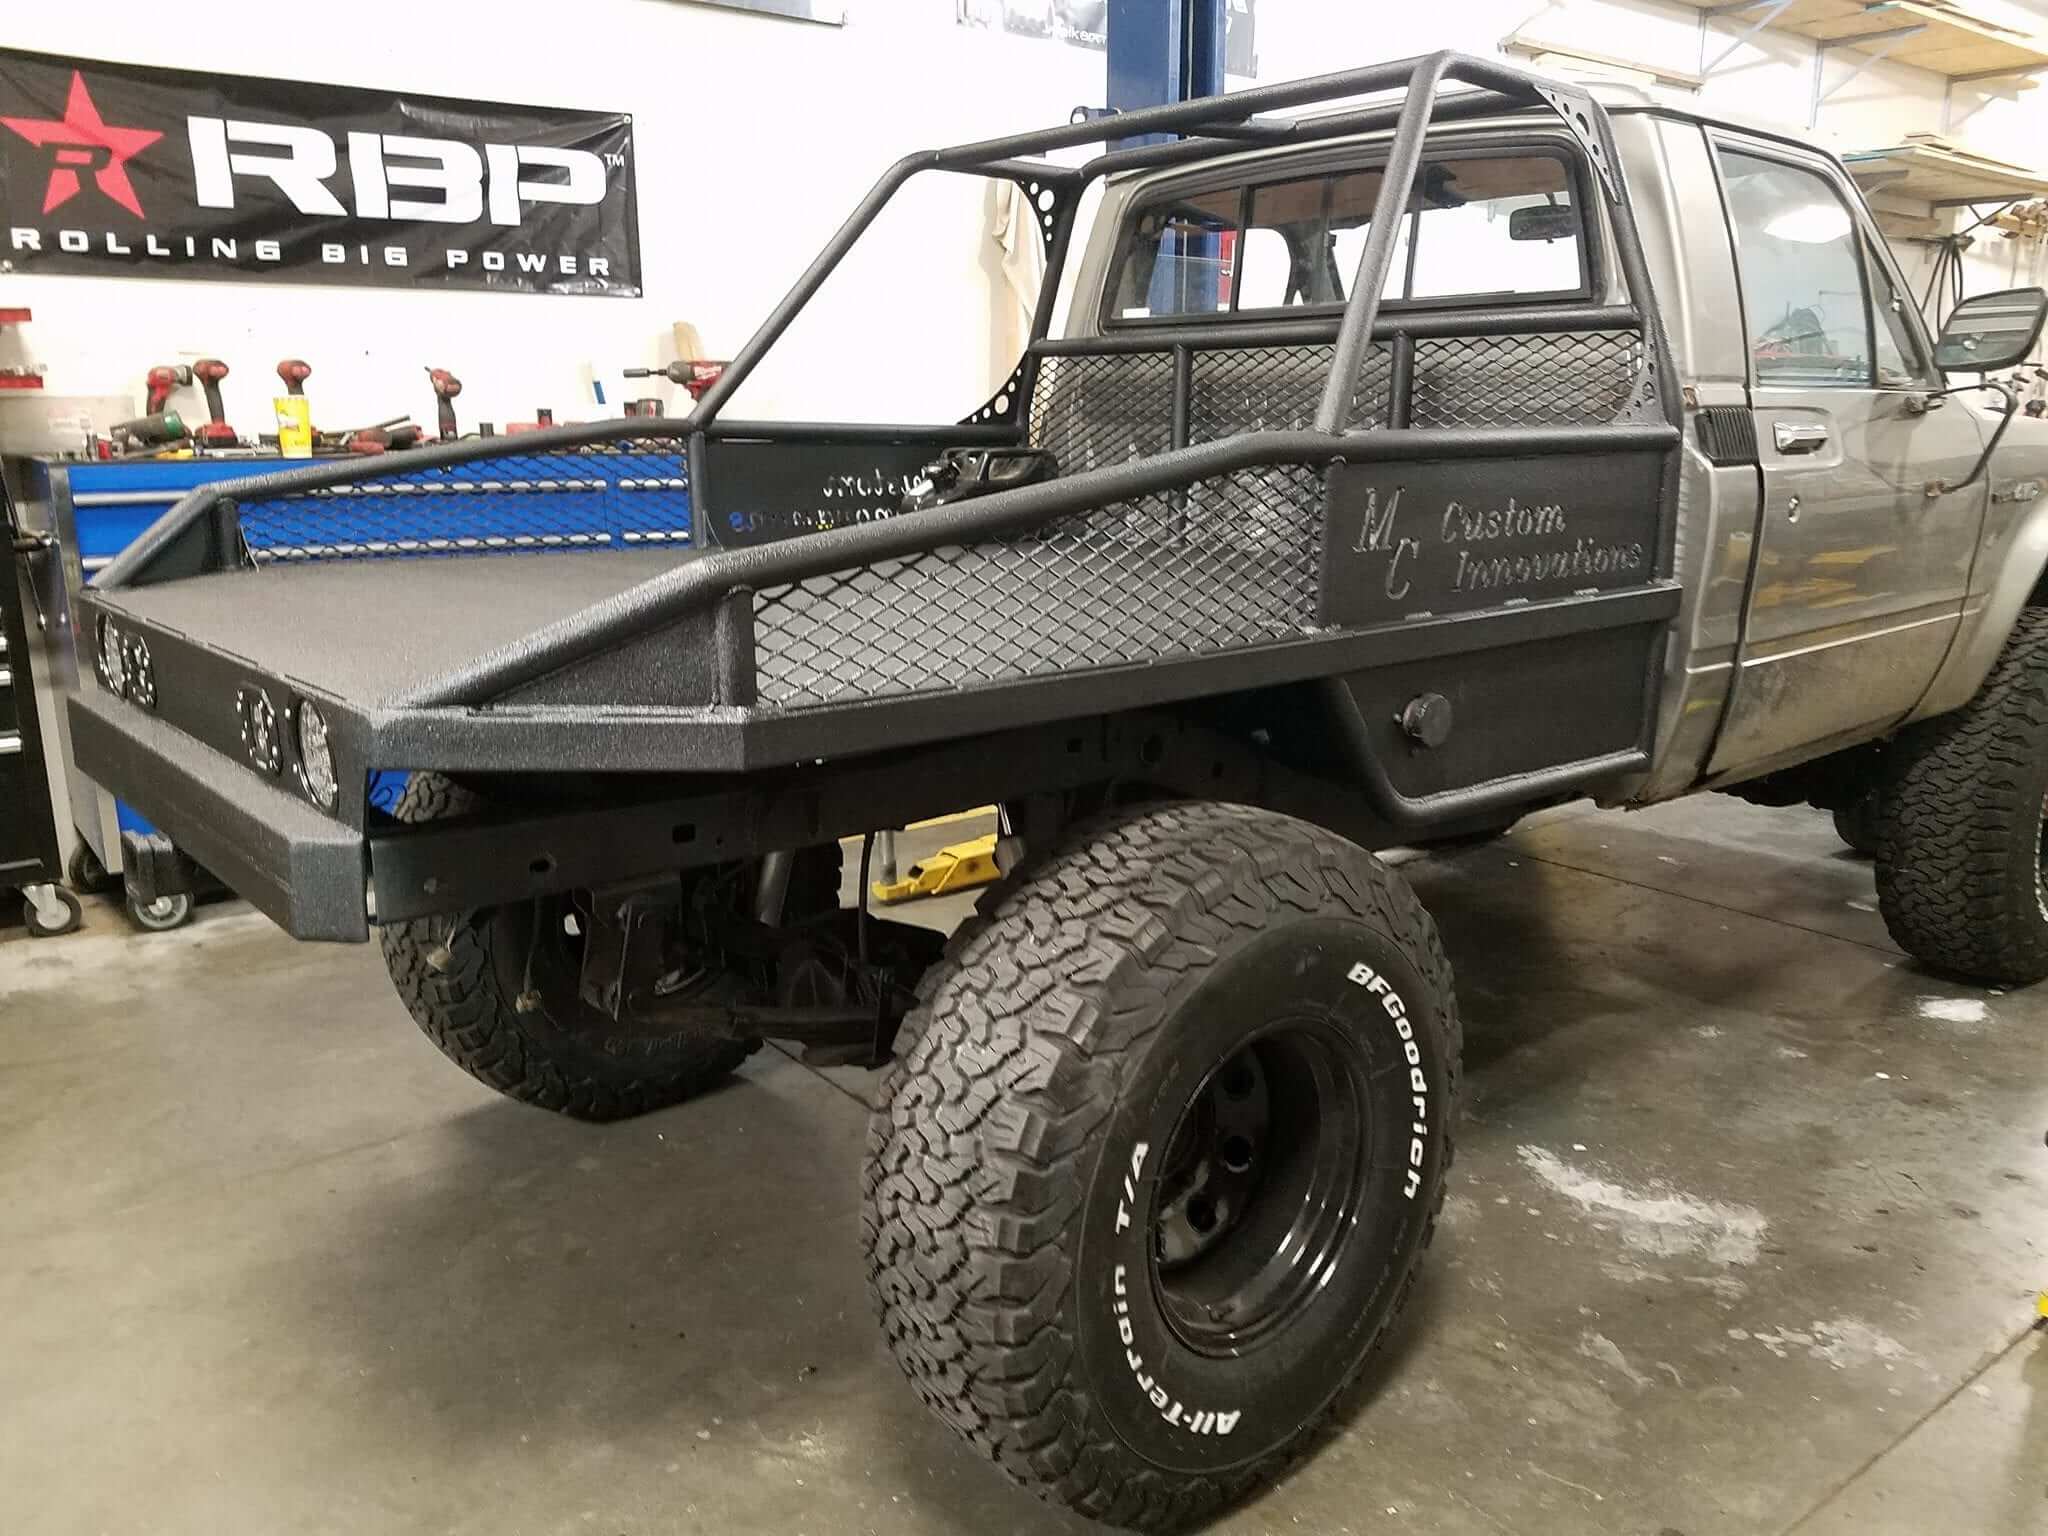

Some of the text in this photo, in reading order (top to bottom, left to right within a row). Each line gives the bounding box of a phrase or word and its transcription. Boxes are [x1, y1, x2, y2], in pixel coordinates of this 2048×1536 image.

[187, 115, 607, 226] RBP
[10, 227, 610, 277] ROLLING BIG POWER
[1441, 497, 1567, 543] Custom
[1451, 537, 1643, 593] Innovations
[1346, 960, 1428, 1200] BFGoodrich
[1115, 1142, 1149, 1235] T/A
